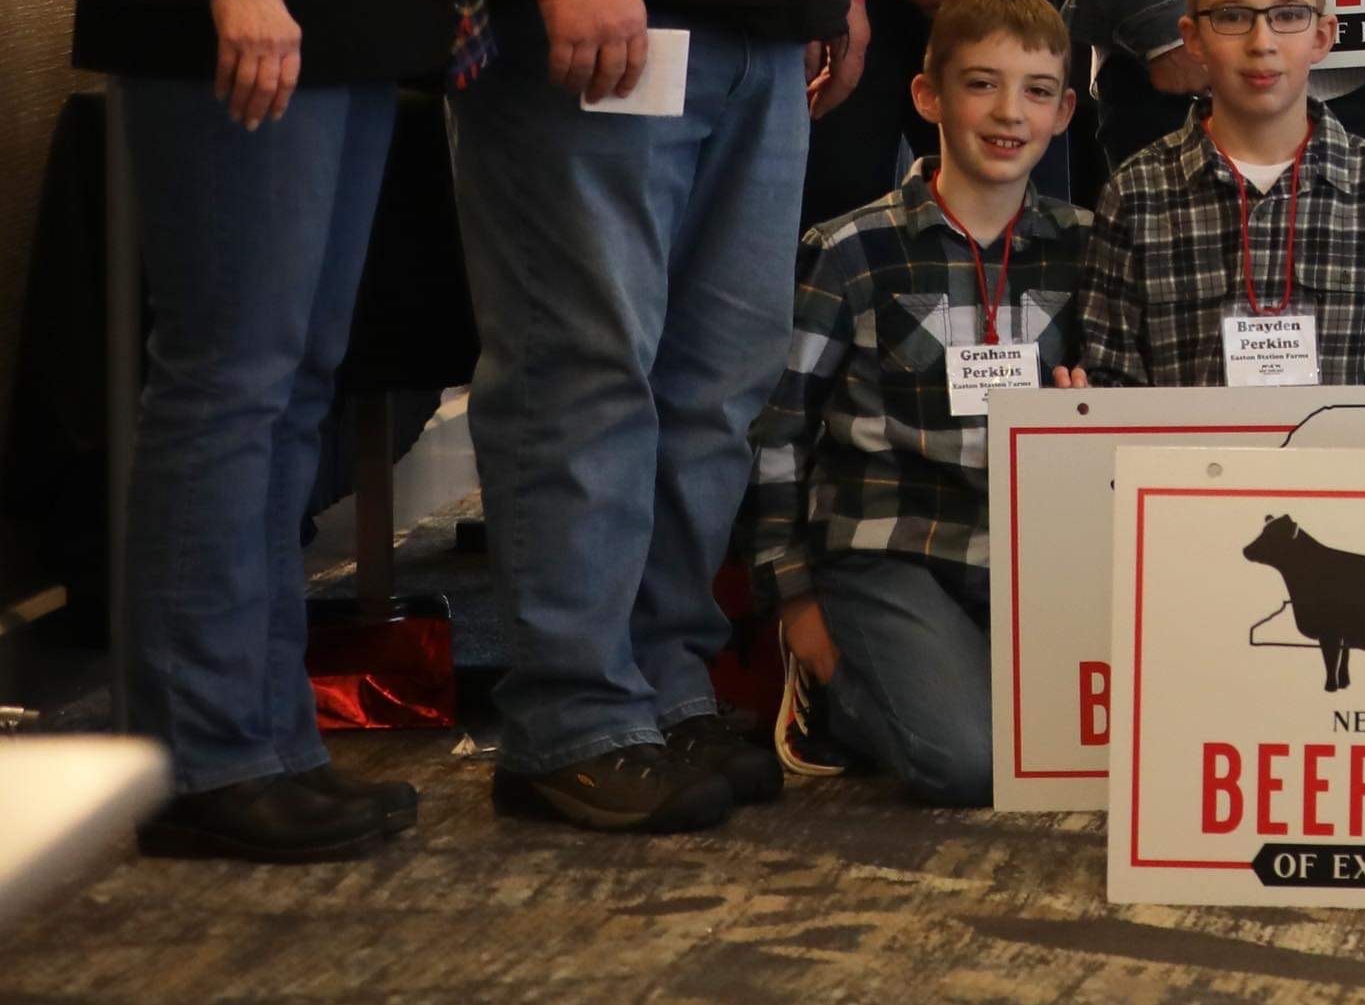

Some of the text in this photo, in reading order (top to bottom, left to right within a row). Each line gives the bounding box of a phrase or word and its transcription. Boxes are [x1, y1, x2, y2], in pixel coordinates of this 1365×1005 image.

[1237, 320, 1301, 334] Brayden
[1240, 338, 1300, 350] Perkins
[960, 349, 1022, 362] Graham
[1273, 853, 1317, 880] OF
